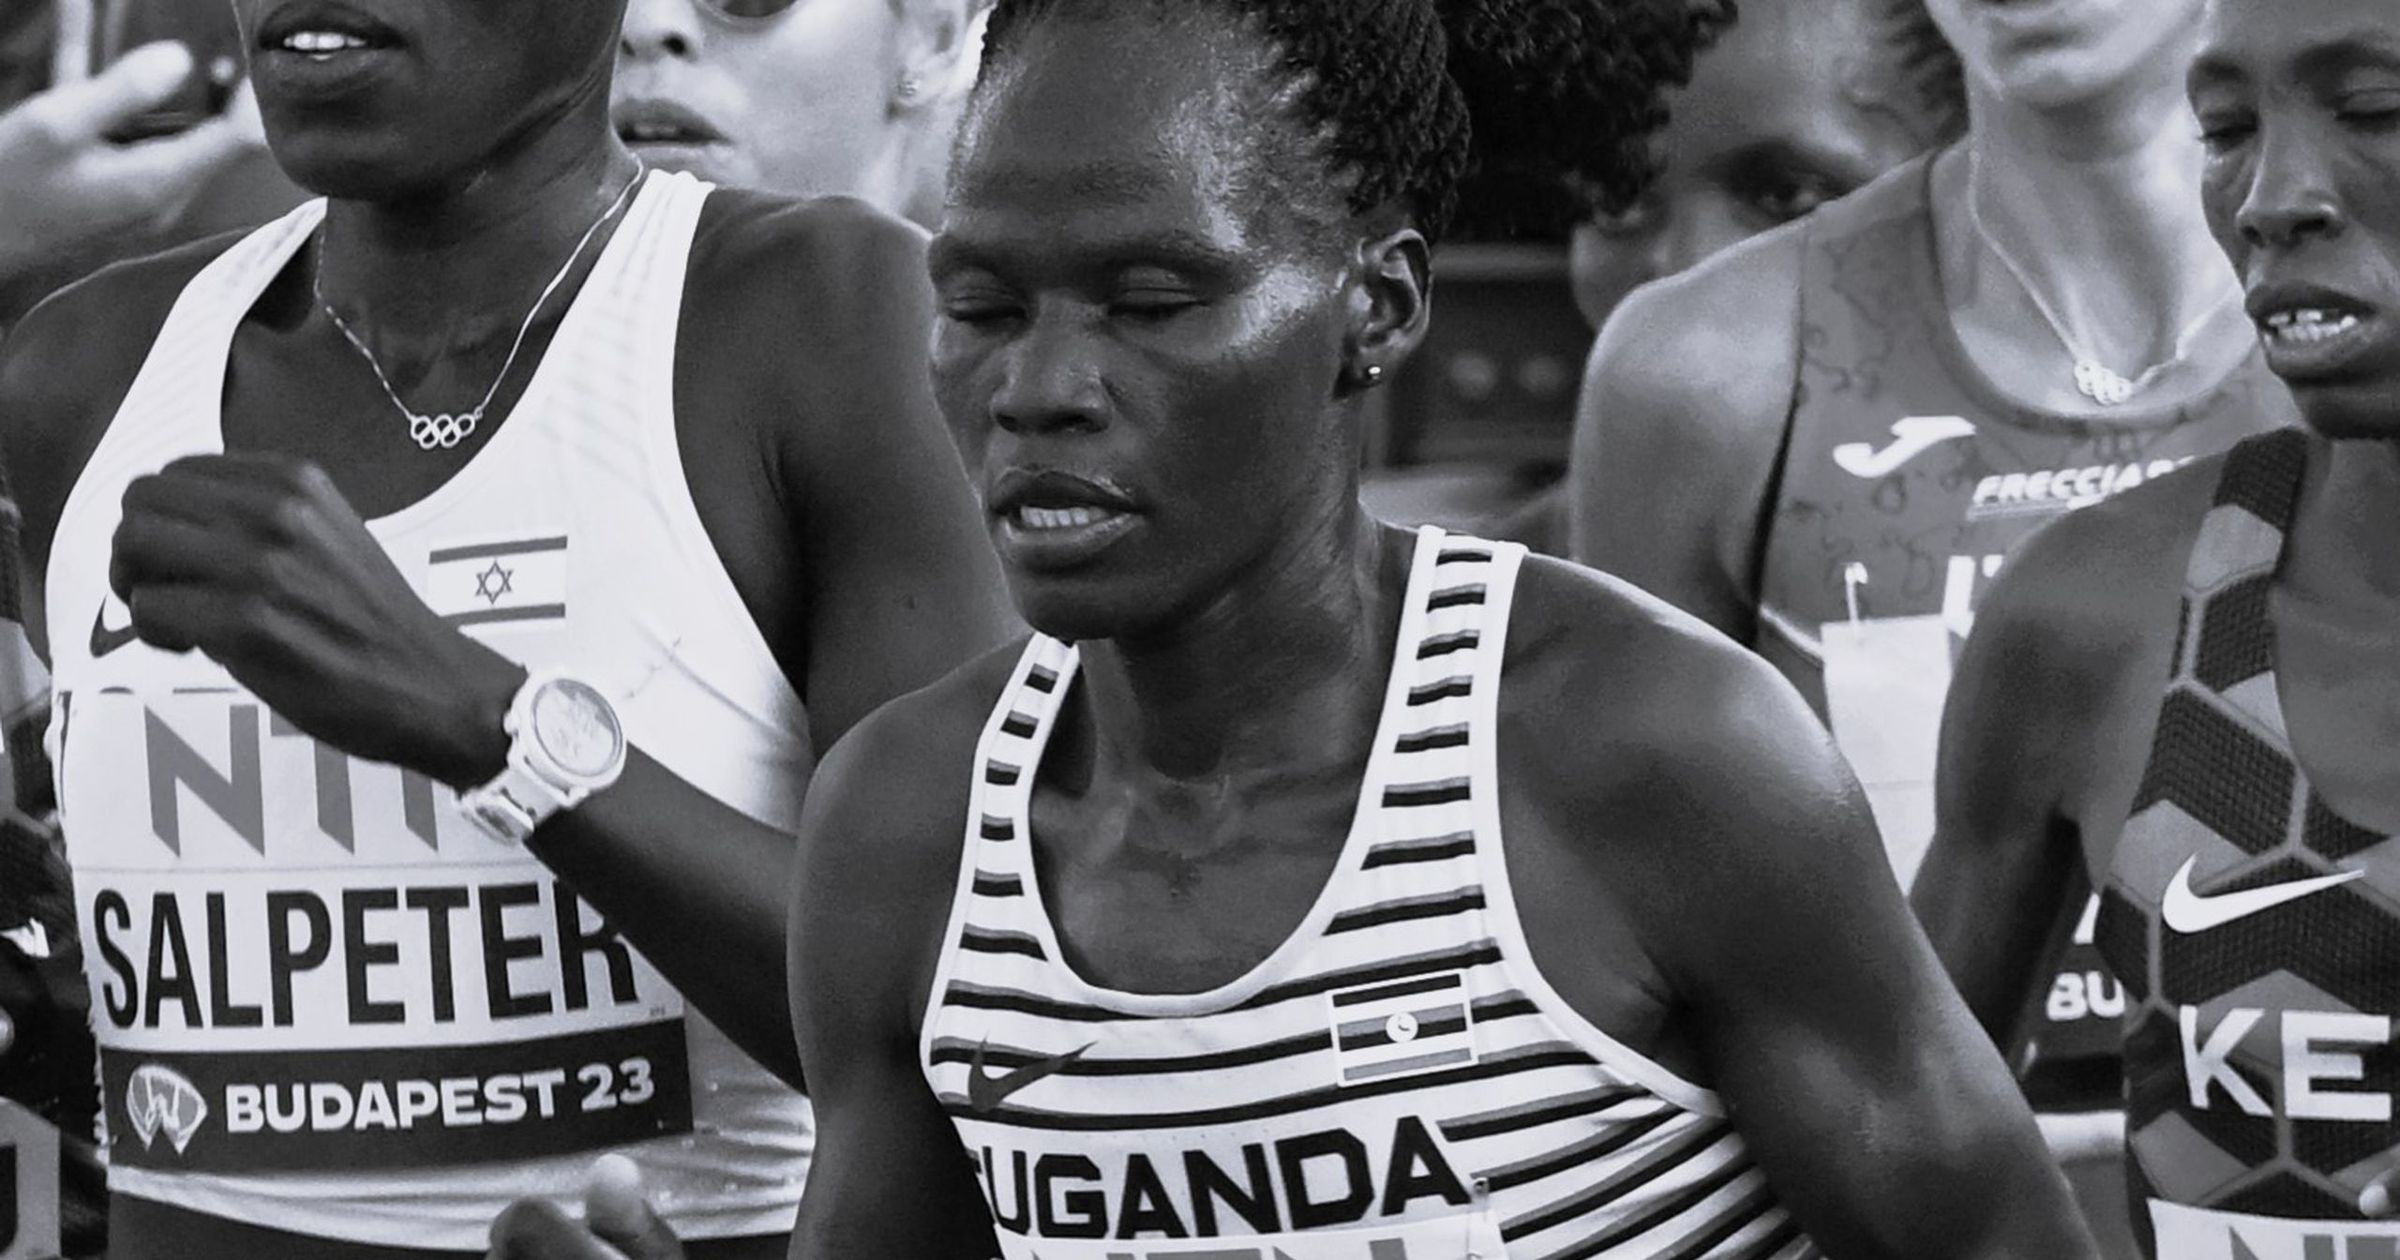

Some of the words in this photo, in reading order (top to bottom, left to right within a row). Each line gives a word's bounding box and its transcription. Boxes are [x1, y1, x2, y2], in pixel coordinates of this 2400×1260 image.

[1972, 454, 2195, 507] FRECCIA
[93, 882, 639, 1031] SALPETER
[225, 1070, 567, 1134] BUDAPEST
[577, 1057, 656, 1112] 23
[981, 1114, 1472, 1241] UGANDA
